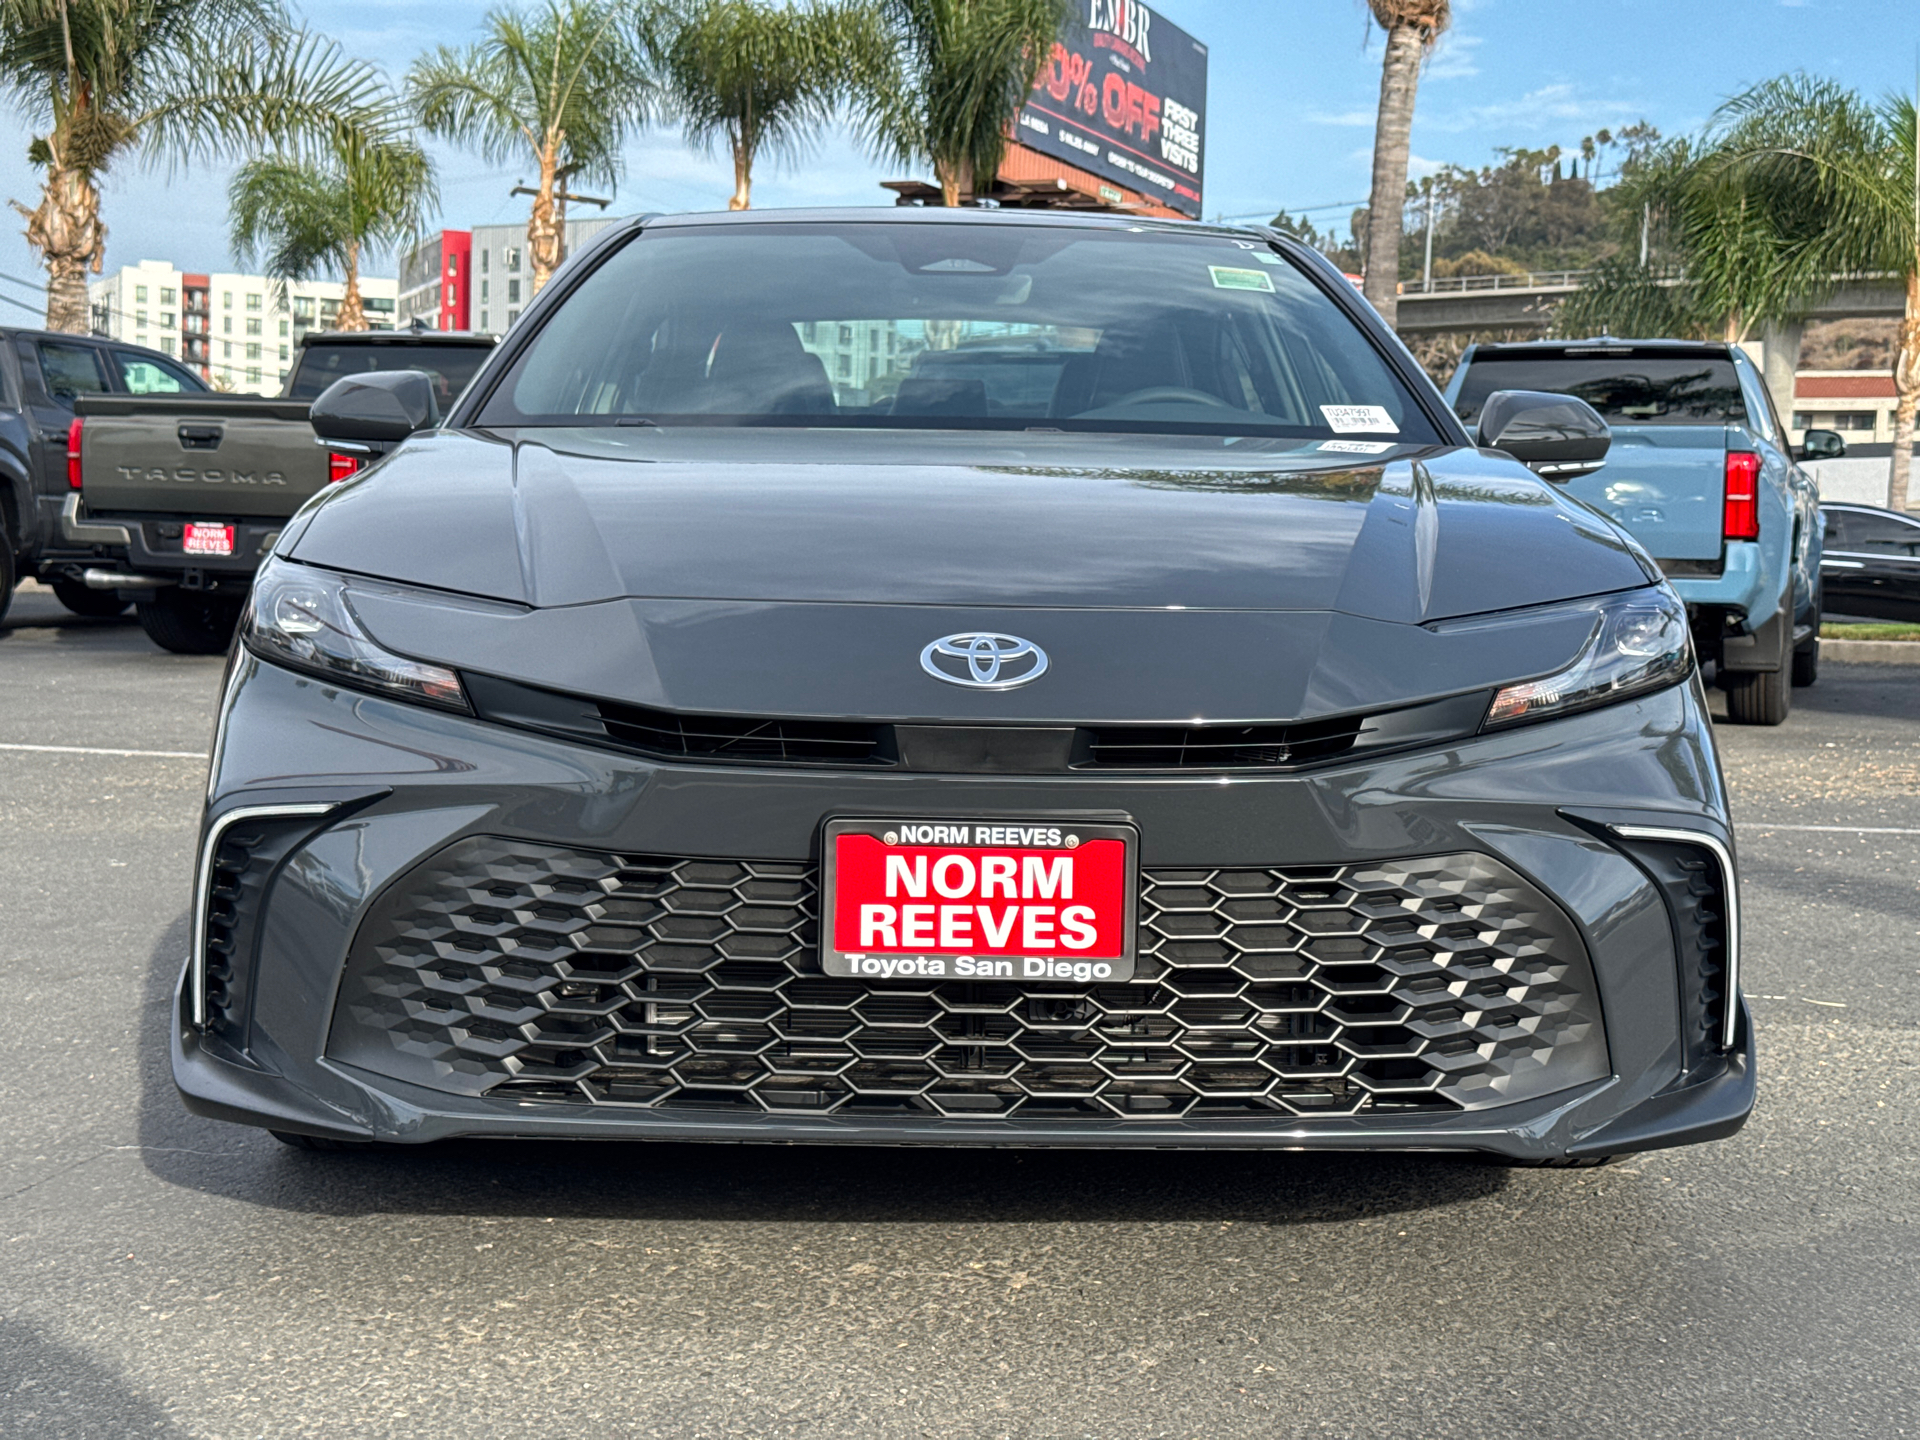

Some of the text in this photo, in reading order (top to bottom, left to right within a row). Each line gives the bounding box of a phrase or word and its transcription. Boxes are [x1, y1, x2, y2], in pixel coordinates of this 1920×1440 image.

[1027, 42, 1098, 115] 0%
[1102, 72, 1161, 142] OFF
[1161, 116, 1199, 153] THREE
[1161, 138, 1198, 174] VISITS
[116, 466, 287, 485] TACOMA
[186, 538, 230, 550] REEVES
[191, 528, 226, 539] NORM
[900, 825, 1062, 846] NORM REEVES
[885, 854, 1074, 899] NORM
[860, 904, 1098, 949] REEVES
[844, 953, 1112, 983] Toyota San Diego
